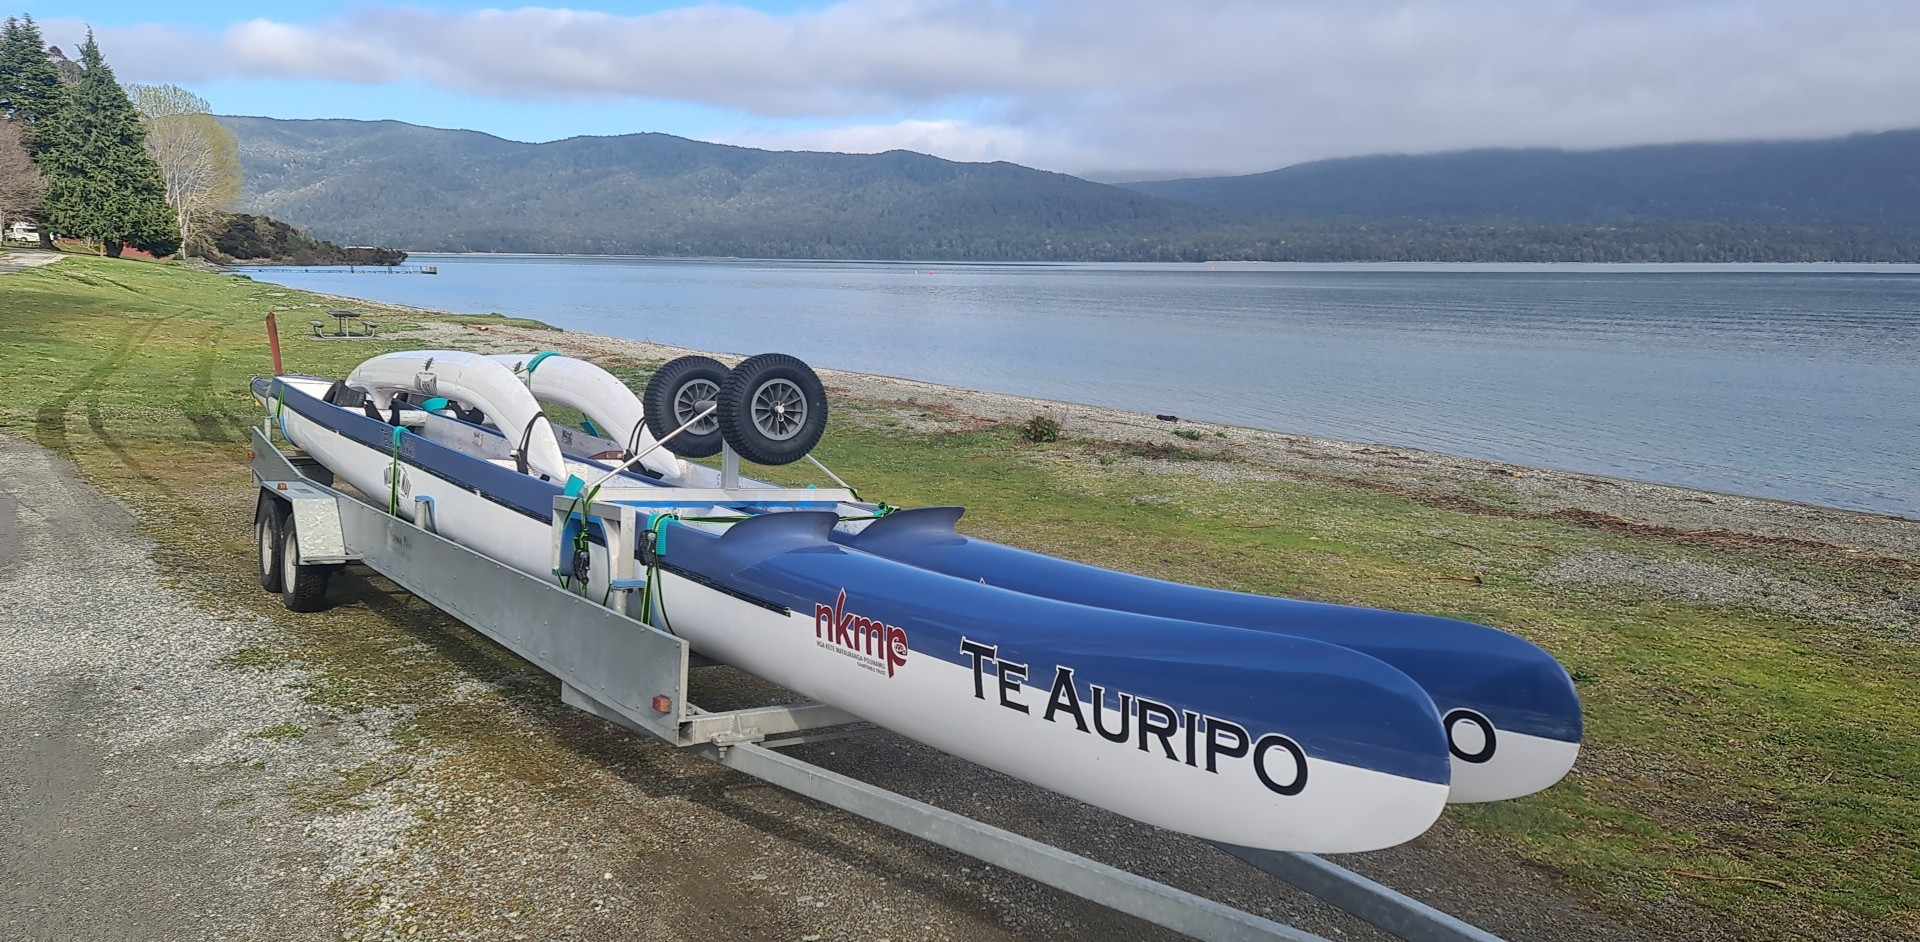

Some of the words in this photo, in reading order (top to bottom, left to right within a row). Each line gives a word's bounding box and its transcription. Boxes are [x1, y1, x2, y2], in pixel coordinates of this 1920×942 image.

[815, 587, 908, 678] nkmp
[960, 636, 1030, 715] TE
[1042, 665, 1309, 796] AURIPO
